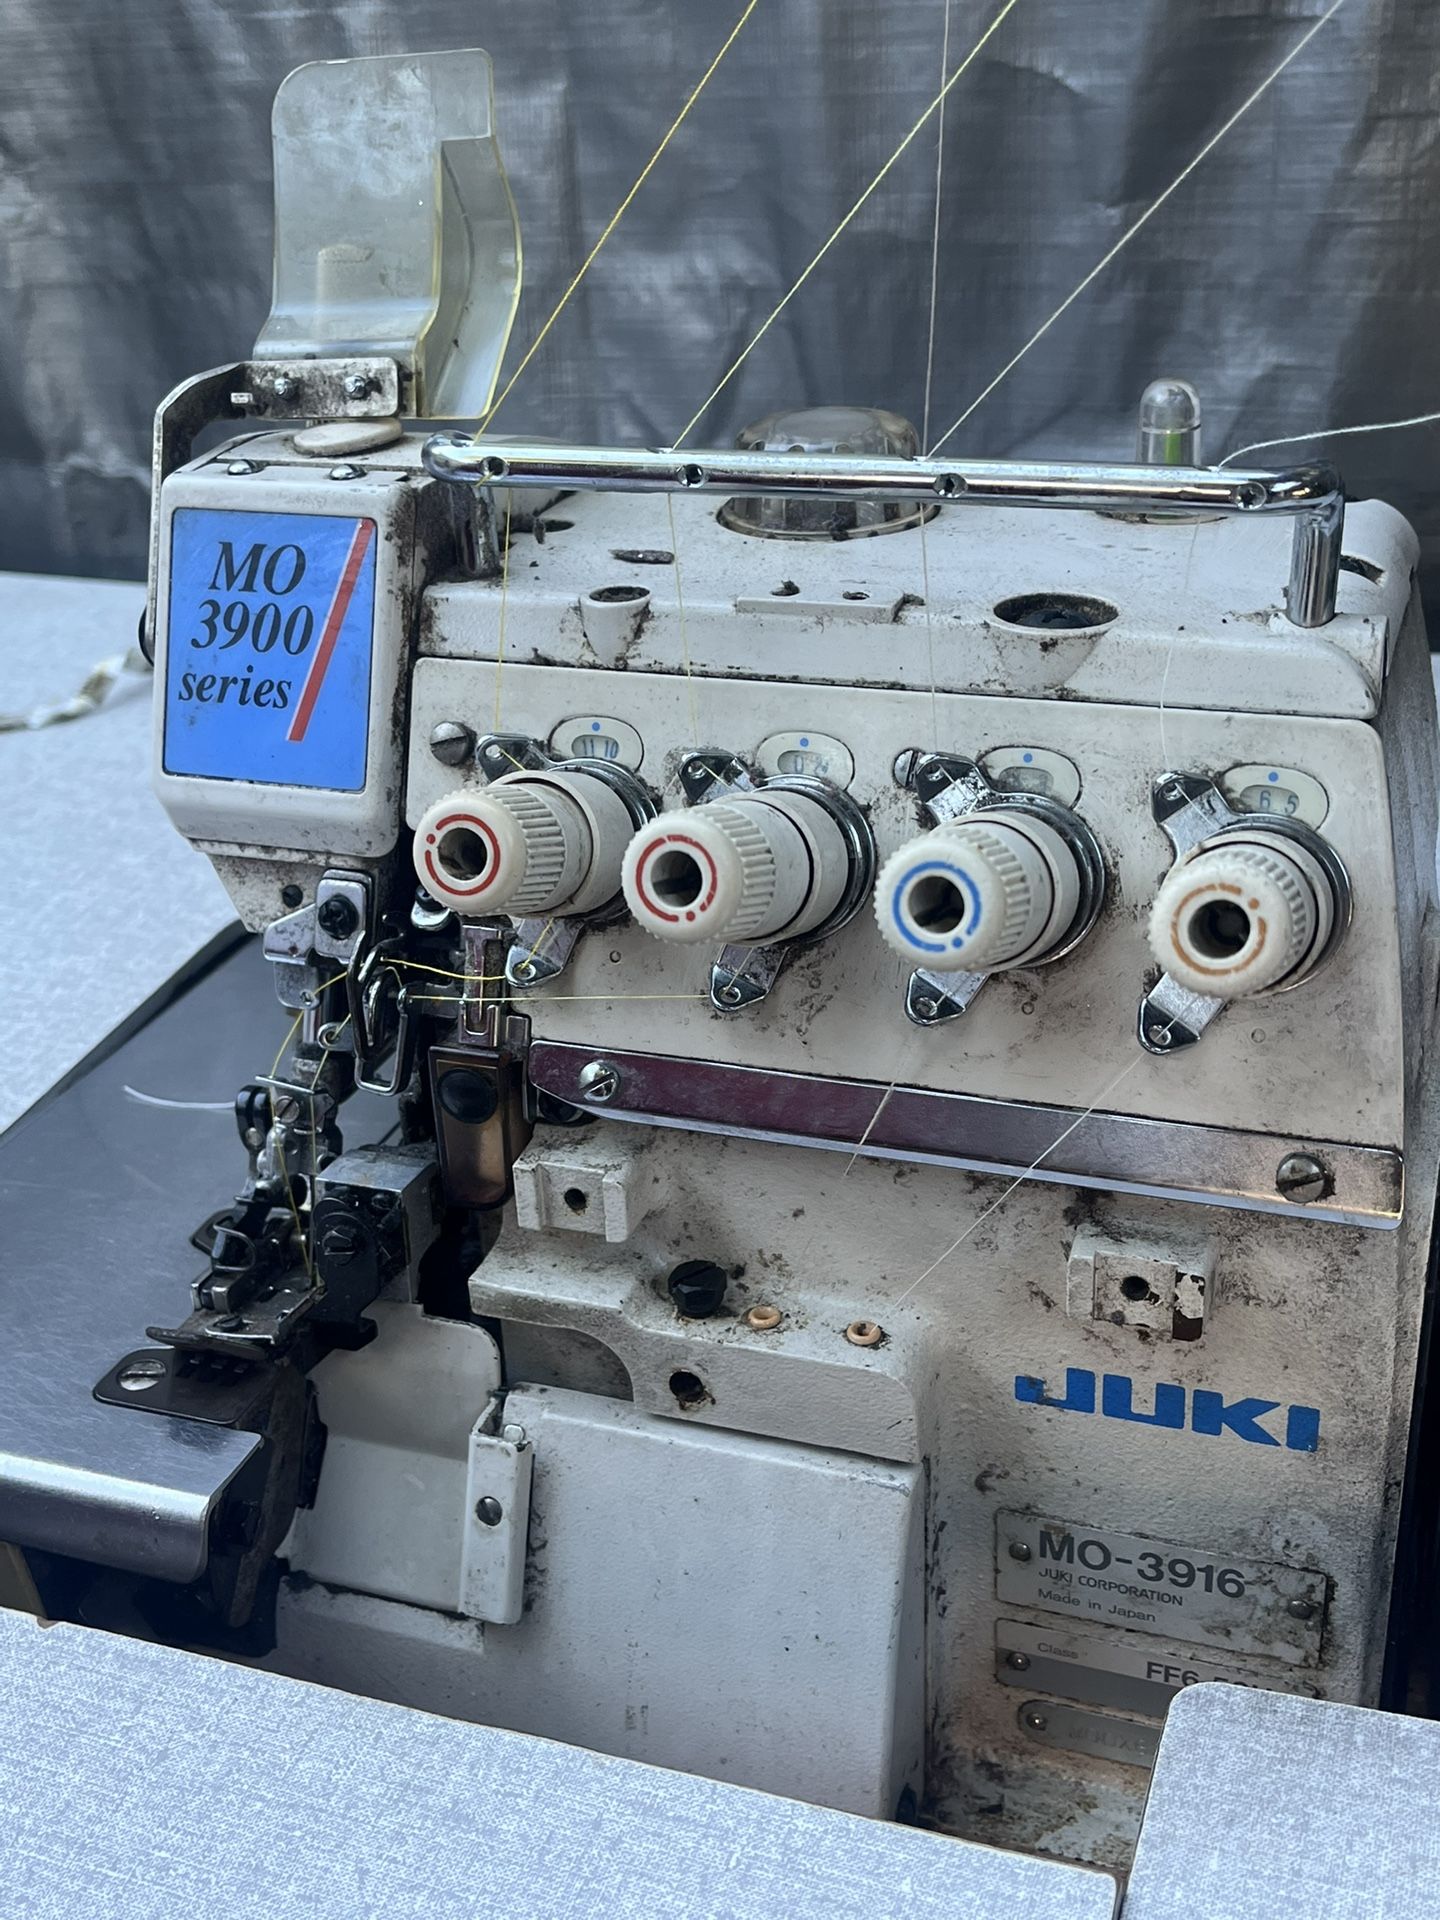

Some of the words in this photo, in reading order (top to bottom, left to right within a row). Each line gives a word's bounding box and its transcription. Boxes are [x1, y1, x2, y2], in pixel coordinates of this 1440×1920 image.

[208, 541, 307, 596] MO
[190, 599, 314, 656] 3900
[178, 664, 292, 709] series
[1015, 1367, 1320, 1453] JUKI
[1038, 1567, 1073, 1584] JUKI
[1078, 1574, 1183, 1606] CORPORATION
[1039, 1530, 1246, 1599] MO-3916
[1038, 1588, 1081, 1606] Made
[1088, 1599, 1102, 1611] in
[1108, 1604, 1156, 1623] Japan
[1037, 1642, 1079, 1660] Class
